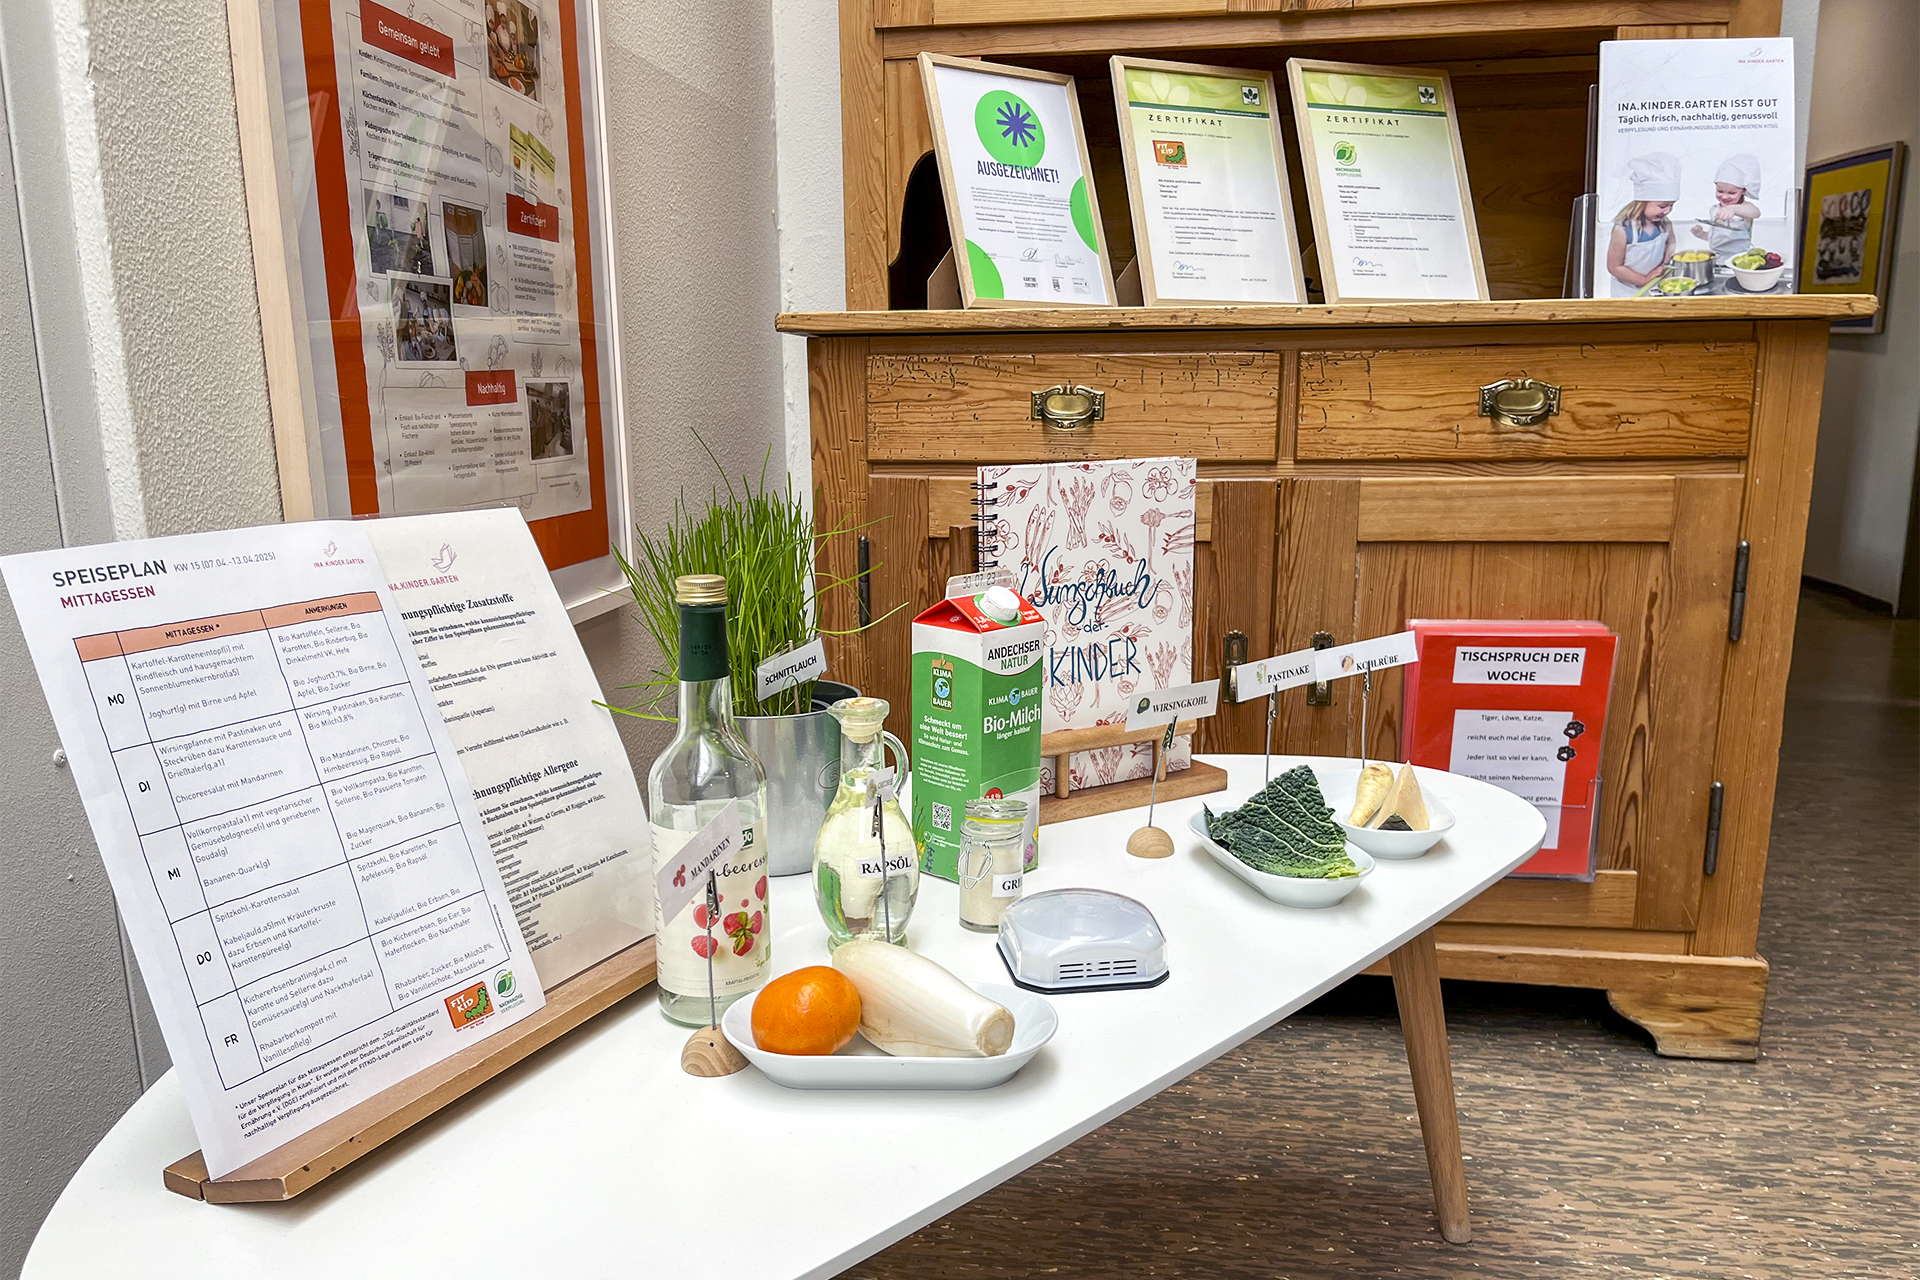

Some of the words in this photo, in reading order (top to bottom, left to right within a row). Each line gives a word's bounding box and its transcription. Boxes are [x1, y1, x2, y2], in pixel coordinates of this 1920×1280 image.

[378, 20, 418, 49] Gemeinsam
[420, 41, 441, 58] gelebt
[1618, 100, 1728, 111] INA.KINDER.GARTEN
[1731, 99, 1754, 108] ISST
[1757, 98, 1778, 107] GUT
[1148, 114, 1222, 127] ZERTIFIKAT
[1326, 115, 1400, 126] ZERTIFIKAT
[1618, 114, 1650, 126] Täglich
[1651, 114, 1679, 123] frisch,
[1681, 112, 1729, 122] nachhaltig,
[1731, 112, 1778, 121] genussvoll
[977, 160, 1060, 184] AUSGEZEICHNET!
[520, 211, 547, 228] Zertifiziert
[477, 383, 506, 396] Nachhaltig
[52, 559, 167, 587] SPEISEPLAN
[173, 563, 188, 572] KW
[190, 561, 201, 570] 15
[201, 552, 276, 569] (07.04.-13.04.2025)
[313, 558, 364, 568] INA.KINDER.GARTEN
[388, 575, 459, 591] NA.KINDER.GARTEN
[60, 585, 156, 609] MITTAGESSEN
[305, 602, 348, 615] ANMERKUNGEN
[400, 602, 466, 620] nungspflichtige
[165, 624, 215, 639] MITTAGESSEN
[987, 640, 1040, 661] ANDECHSER
[1461, 651, 1550, 662] TISCHSPRUCH
[1553, 652, 1579, 663] DER
[135, 668, 178, 682] Rindfleisch
[179, 665, 193, 674] und
[194, 655, 254, 671] hausgemachtem
[1000, 655, 1029, 670] NATUR
[1049, 637, 1142, 688] KINDER
[765, 655, 817, 686] SCHNITTLAUCH
[932, 668, 953, 679] KLIMA
[1267, 664, 1310, 683] PASTINAKE
[1487, 671, 1536, 681] WOCHE
[107, 693, 125, 706] MO
[932, 698, 952, 708] BAUER
[988, 695, 1009, 706] KLIMA
[1020, 687, 1038, 698] BAUER
[1152, 695, 1209, 713] WIRSINGKOHL
[923, 715, 951, 729] Schmeckt
[983, 704, 1041, 734] Bio-Milch
[1481, 714, 1500, 722] Tiger,
[159, 738, 212, 755] Wirsingpfanne
[214, 733, 227, 742] mit
[227, 725, 267, 738] Pastinaken
[268, 720, 282, 729] und
[919, 723, 931, 732] eine
[931, 725, 944, 735] Welt
[944, 728, 968, 740] besser!
[996, 730, 1013, 740] länger
[1013, 726, 1031, 736] haltbar
[163, 752, 206, 767] Steckrüben
[207, 747, 225, 756] dazu
[225, 734, 277, 751] Karottensauce
[278, 729, 292, 738] und
[138, 780, 151, 793] DI
[175, 784, 226, 803] Chicoreesalat
[227, 780, 240, 789] mit
[240, 770, 283, 785] Mandarinen
[472, 771, 542, 800] hnungspflichtige
[543, 759, 579, 777] Allergene
[690, 835, 732, 881] MANDARINEN
[167, 867, 181, 880] MI
[215, 887, 300, 922] Spitzkohl-Karottensalat
[196, 951, 212, 965] DO
[450, 994, 465, 1008] FIT
[457, 998, 474, 1013] KID
[224, 1033, 239, 1048] FR
